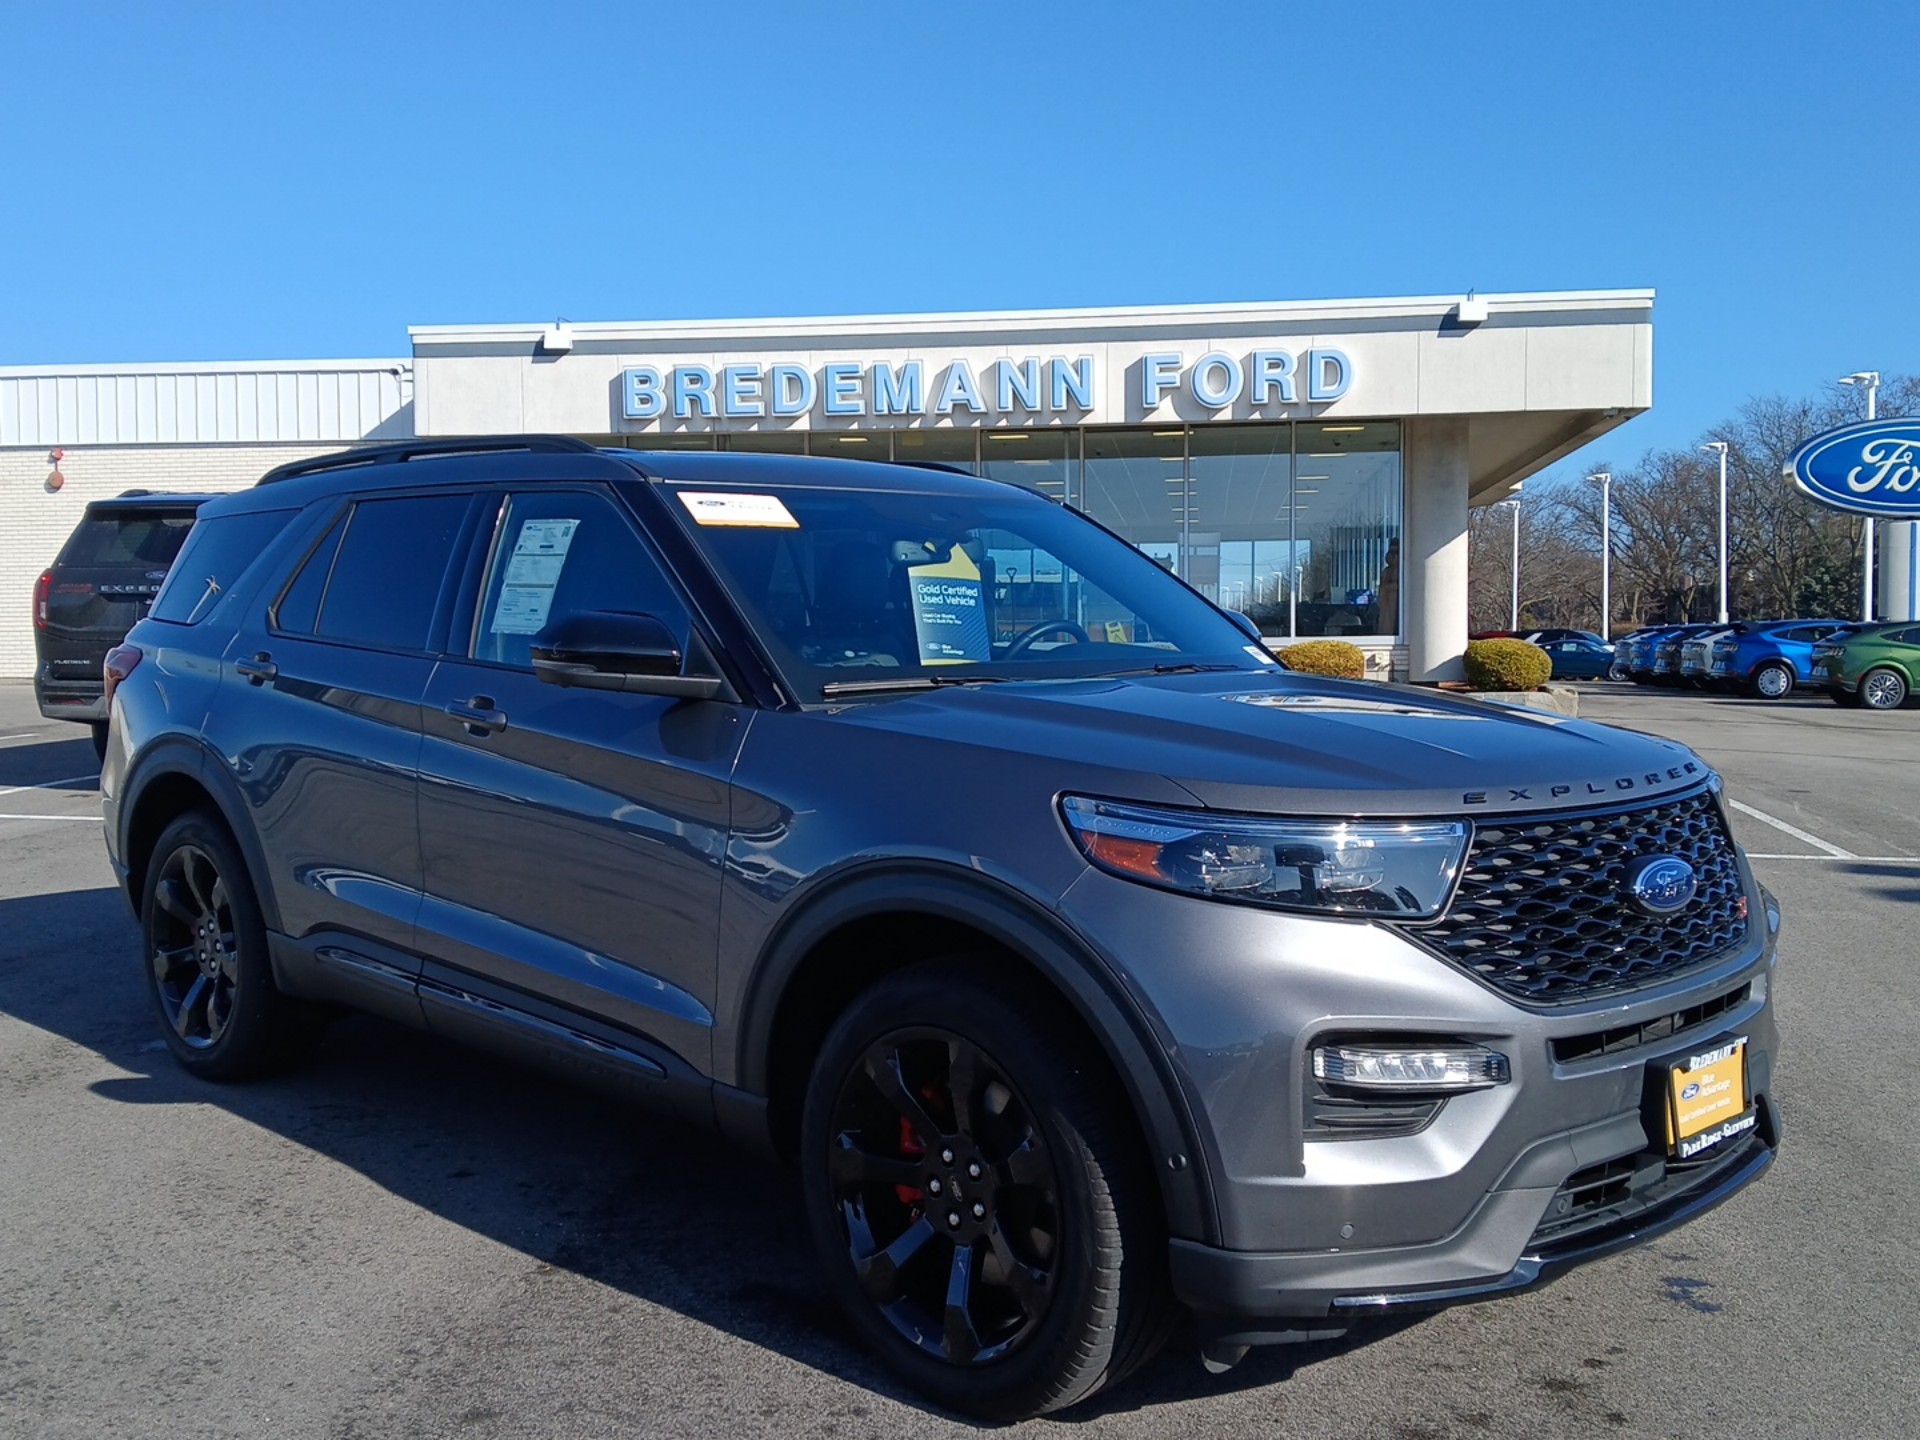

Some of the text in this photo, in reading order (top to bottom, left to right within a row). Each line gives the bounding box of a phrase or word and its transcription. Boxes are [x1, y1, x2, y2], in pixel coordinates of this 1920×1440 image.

[623, 346, 1355, 419] BREDEMANN FORD
[1847, 438, 1920, 493] Fo
[100, 584, 160, 593] EXPED
[917, 584, 978, 597] Gold Certified
[919, 595, 976, 606] Used Vehicle
[1463, 761, 1698, 805] EXPLORER
